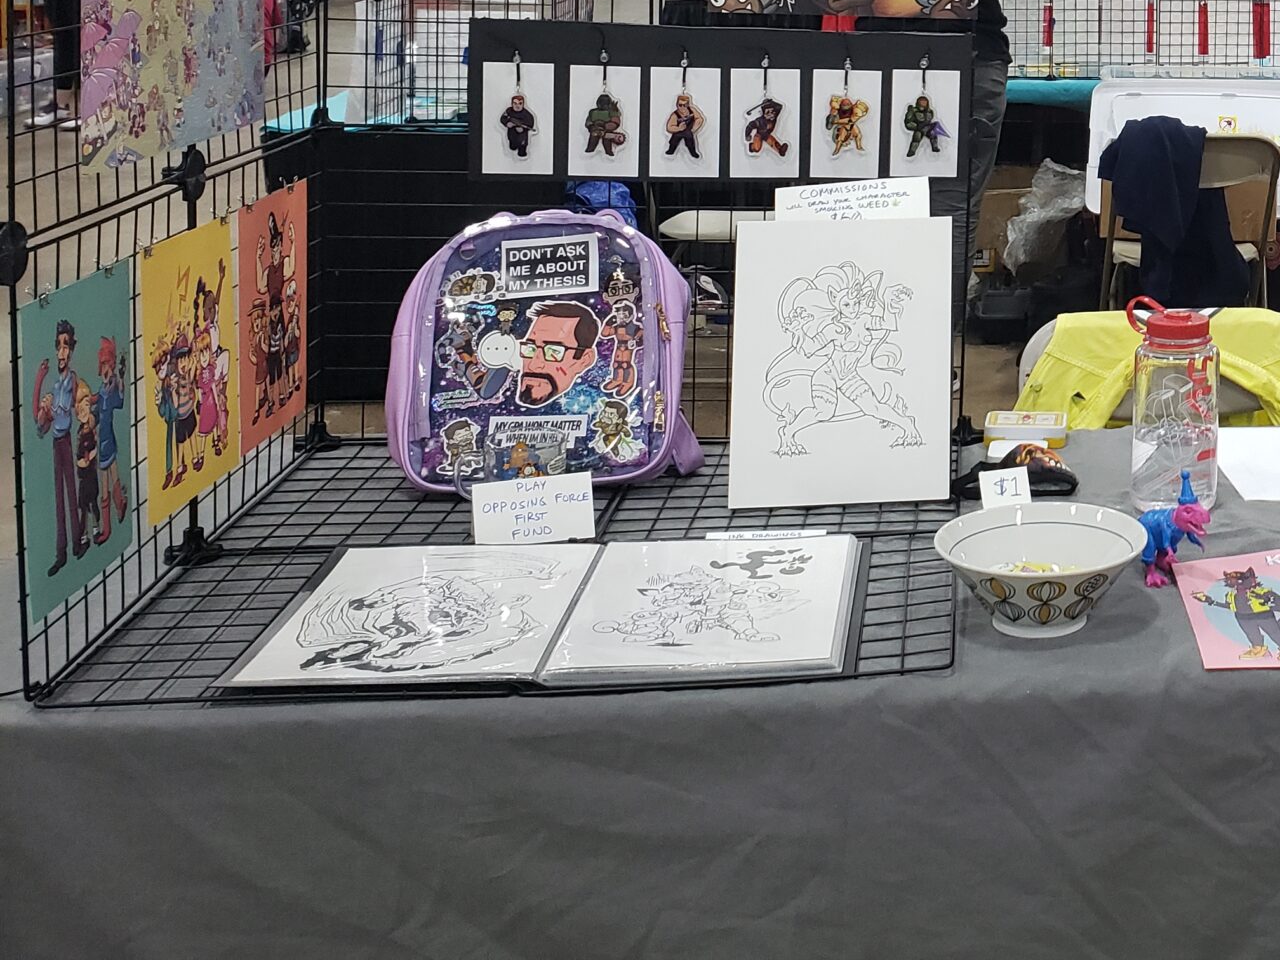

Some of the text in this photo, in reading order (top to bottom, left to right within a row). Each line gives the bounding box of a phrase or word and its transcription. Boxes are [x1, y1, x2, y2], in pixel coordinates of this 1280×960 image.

[800, 182, 887, 200] COMMISSIONS
[856, 191, 910, 201] CHARACTER
[858, 200, 889, 209] WEED
[509, 244, 586, 262] DON'T ASK
[509, 260, 586, 277] ME ABOUT
[509, 274, 586, 291] MY THESIS
[494, 421, 508, 432] MY
[551, 420, 582, 431] MATTER
[506, 433, 528, 443] WHEN
[516, 480, 547, 492] PLAY
[993, 477, 1021, 497] $1
[482, 492, 589, 513] OPPOSING FORCE
[514, 512, 547, 525] FIRST
[511, 526, 552, 540] FUND
